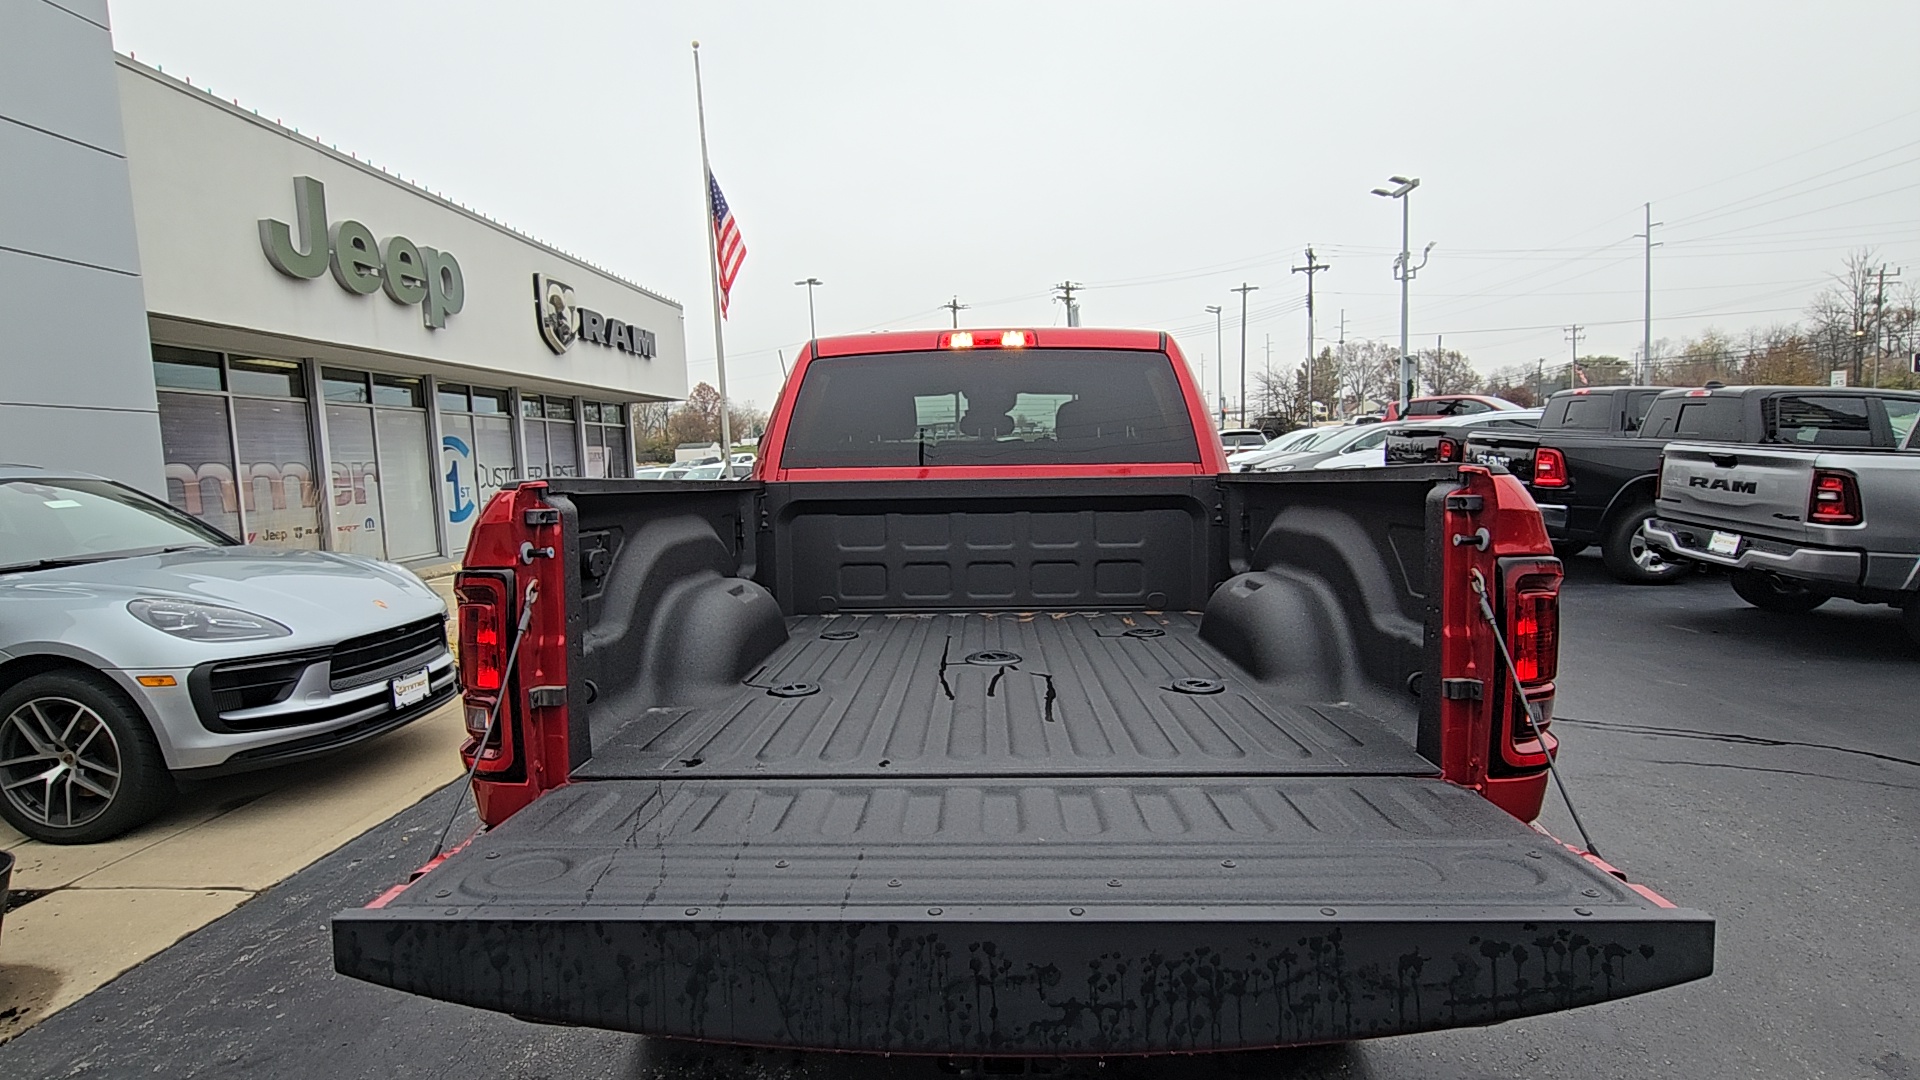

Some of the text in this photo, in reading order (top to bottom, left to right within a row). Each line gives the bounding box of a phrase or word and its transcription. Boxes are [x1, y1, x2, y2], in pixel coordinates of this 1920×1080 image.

[258, 175, 465, 329] Jeep
[577, 307, 657, 358] RAM
[479, 463, 542, 489] CUSTOER
[1689, 476, 1758, 494] RAM
[262, 529, 288, 542] Jeep
